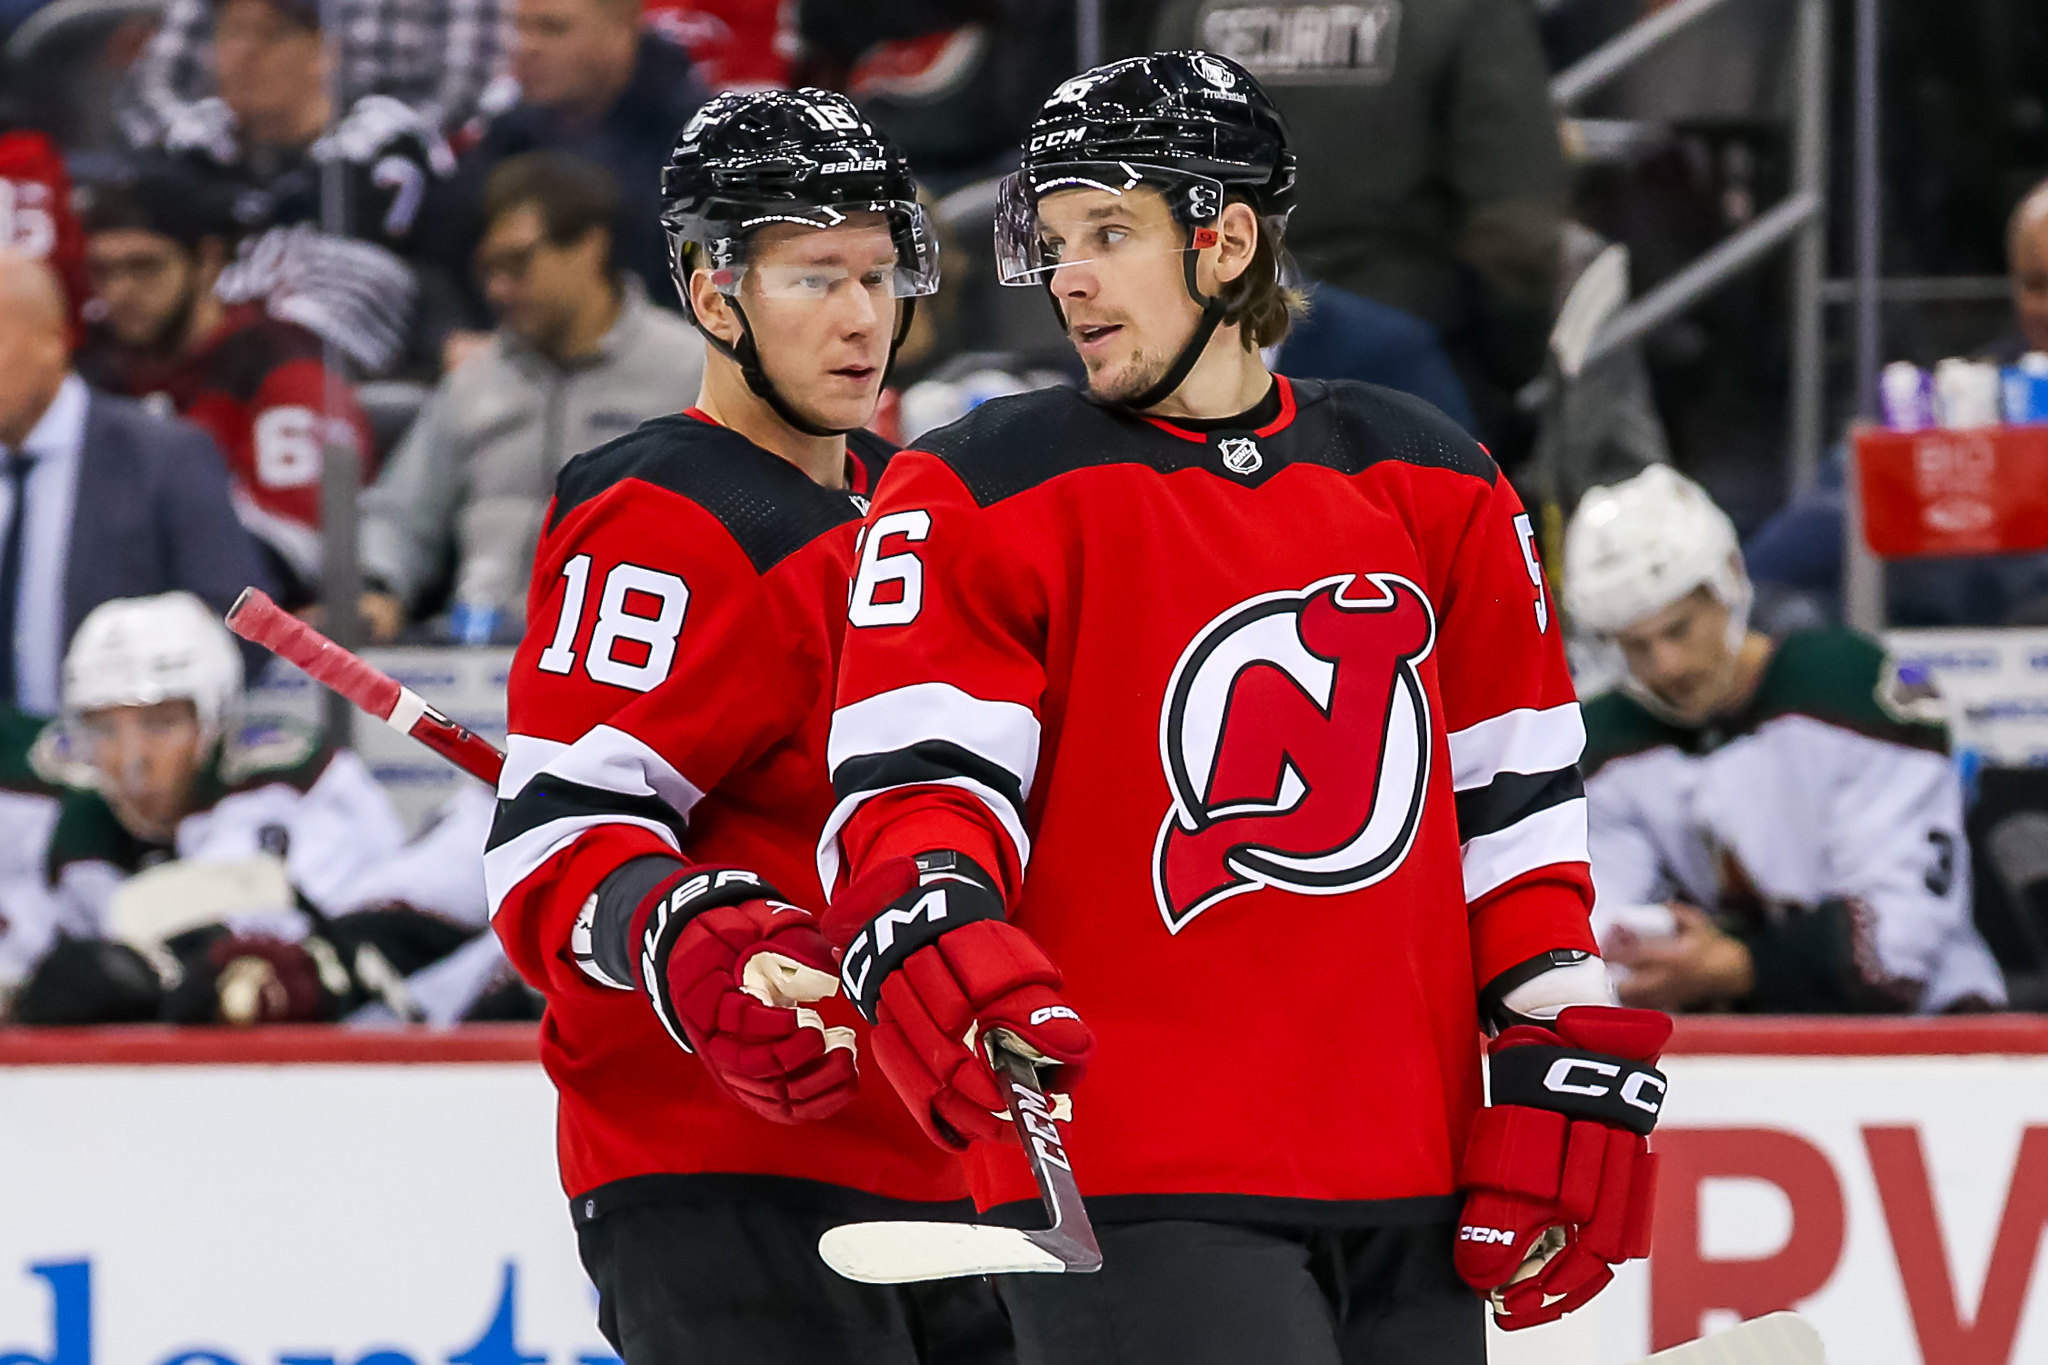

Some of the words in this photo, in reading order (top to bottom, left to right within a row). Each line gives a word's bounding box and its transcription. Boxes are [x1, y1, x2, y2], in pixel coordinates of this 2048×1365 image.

[804, 104, 858, 131] 18
[1030, 126, 1087, 151] CCM
[820, 159, 887, 174] BAUER
[848, 508, 933, 628] 6
[537, 552, 692, 693] 18
[842, 888, 948, 1021] CM
[1011, 1082, 1072, 1172] CCM
[1460, 1225, 1515, 1246] CCM
